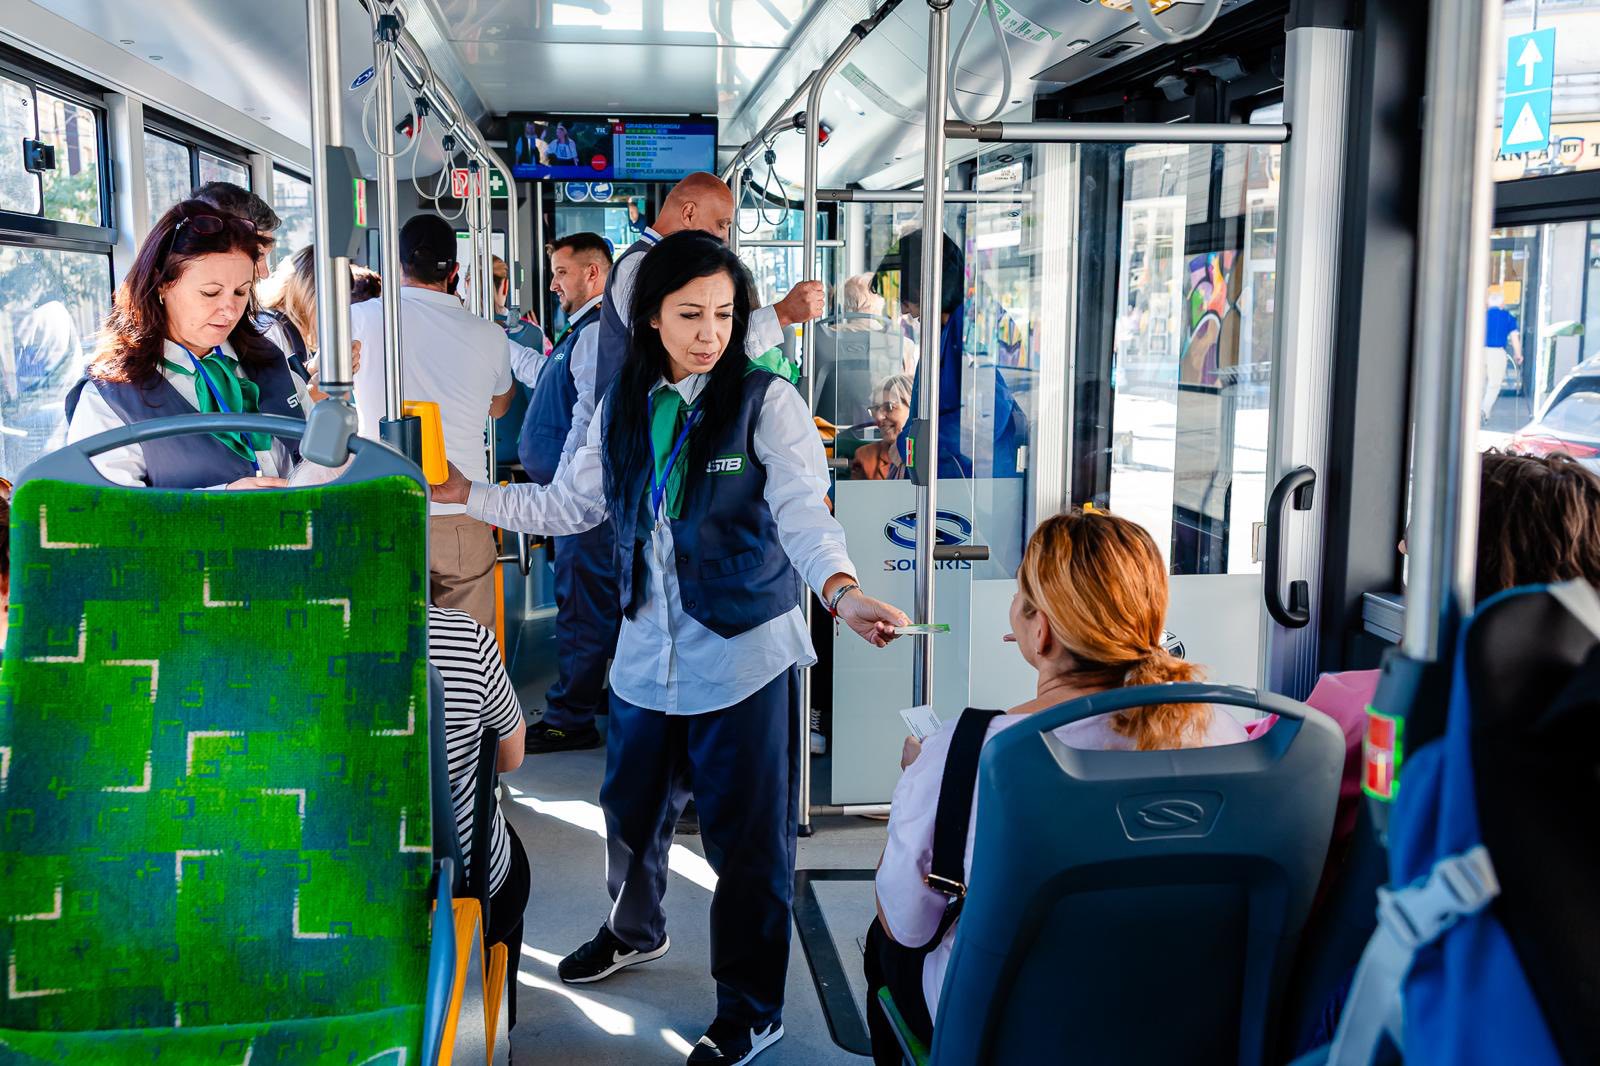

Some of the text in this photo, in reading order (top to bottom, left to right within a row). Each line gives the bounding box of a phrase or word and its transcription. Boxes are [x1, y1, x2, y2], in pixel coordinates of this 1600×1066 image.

[1563, 144, 1579, 153] BT
[706, 457, 742, 473] STB
[883, 559, 971, 571] SORIS
